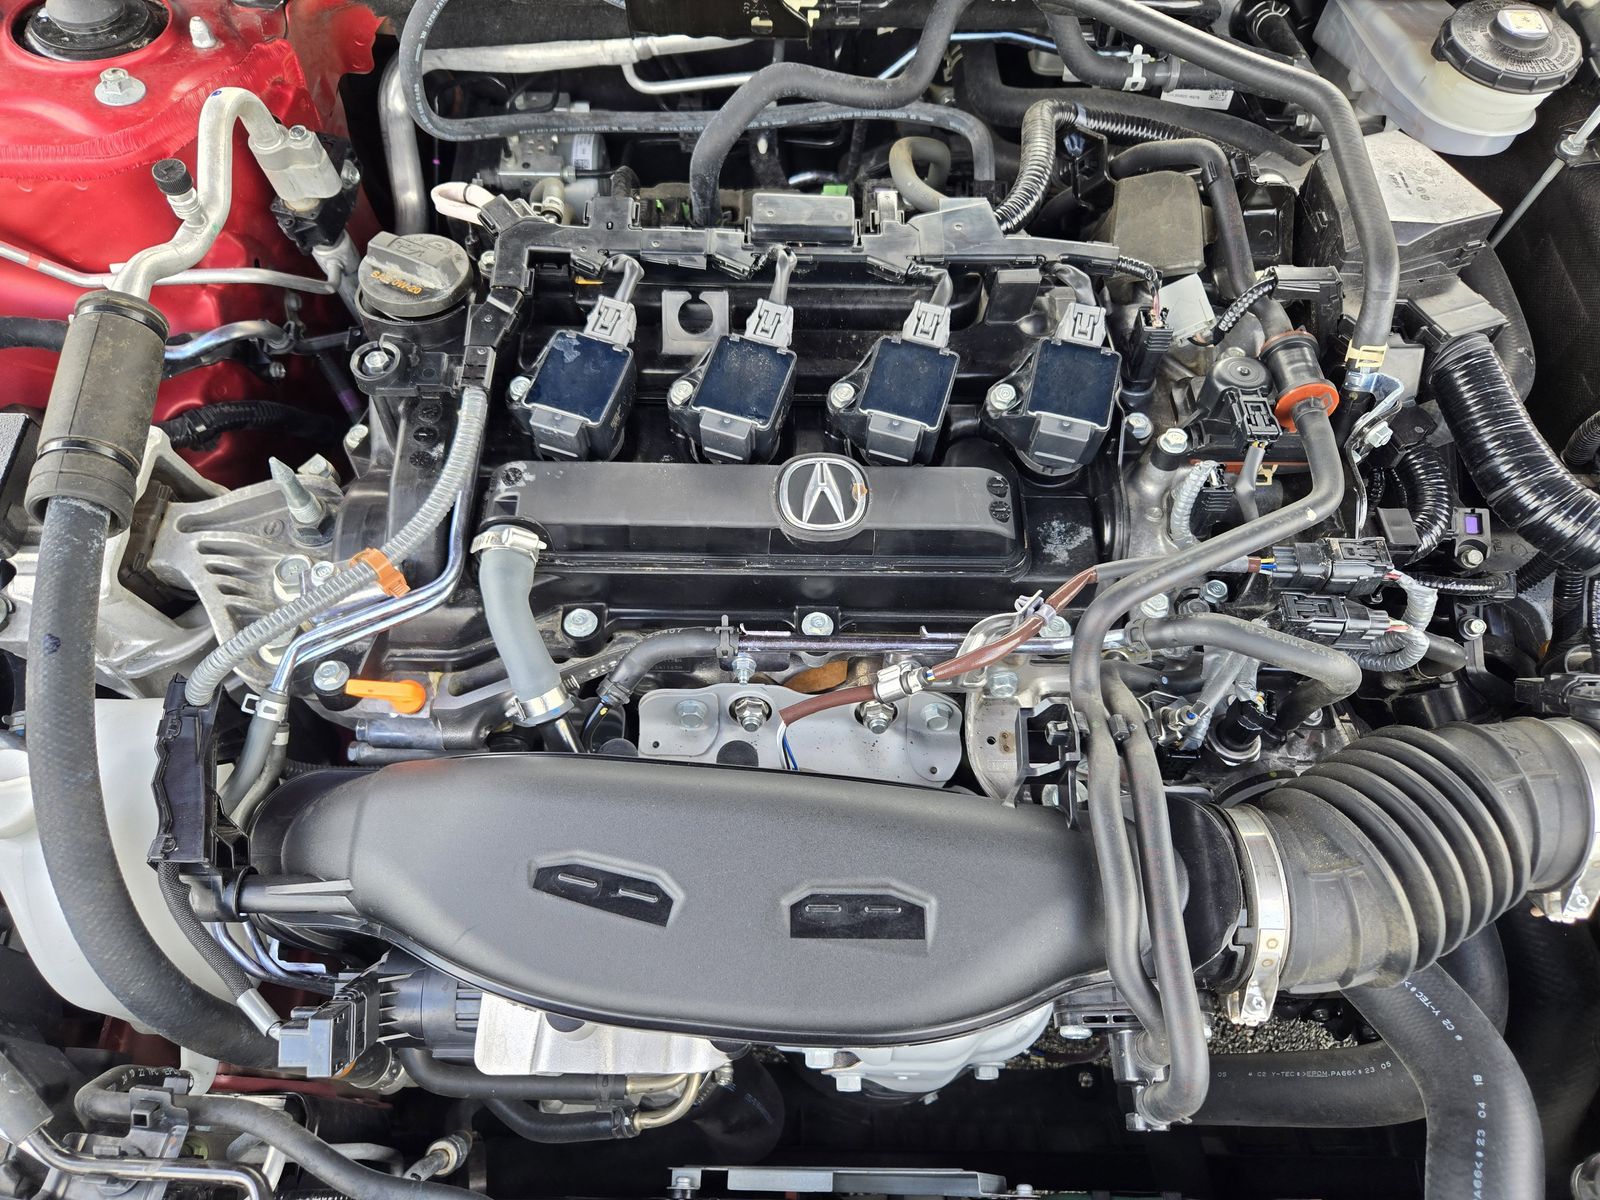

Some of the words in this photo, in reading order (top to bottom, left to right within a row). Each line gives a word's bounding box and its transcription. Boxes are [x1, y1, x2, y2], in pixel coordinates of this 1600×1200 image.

[391, 279, 423, 296] 0W-20
[1380, 1060, 1392, 1070] 05
[1477, 1101, 1487, 1119] 04
[1475, 1128, 1487, 1147] 23
